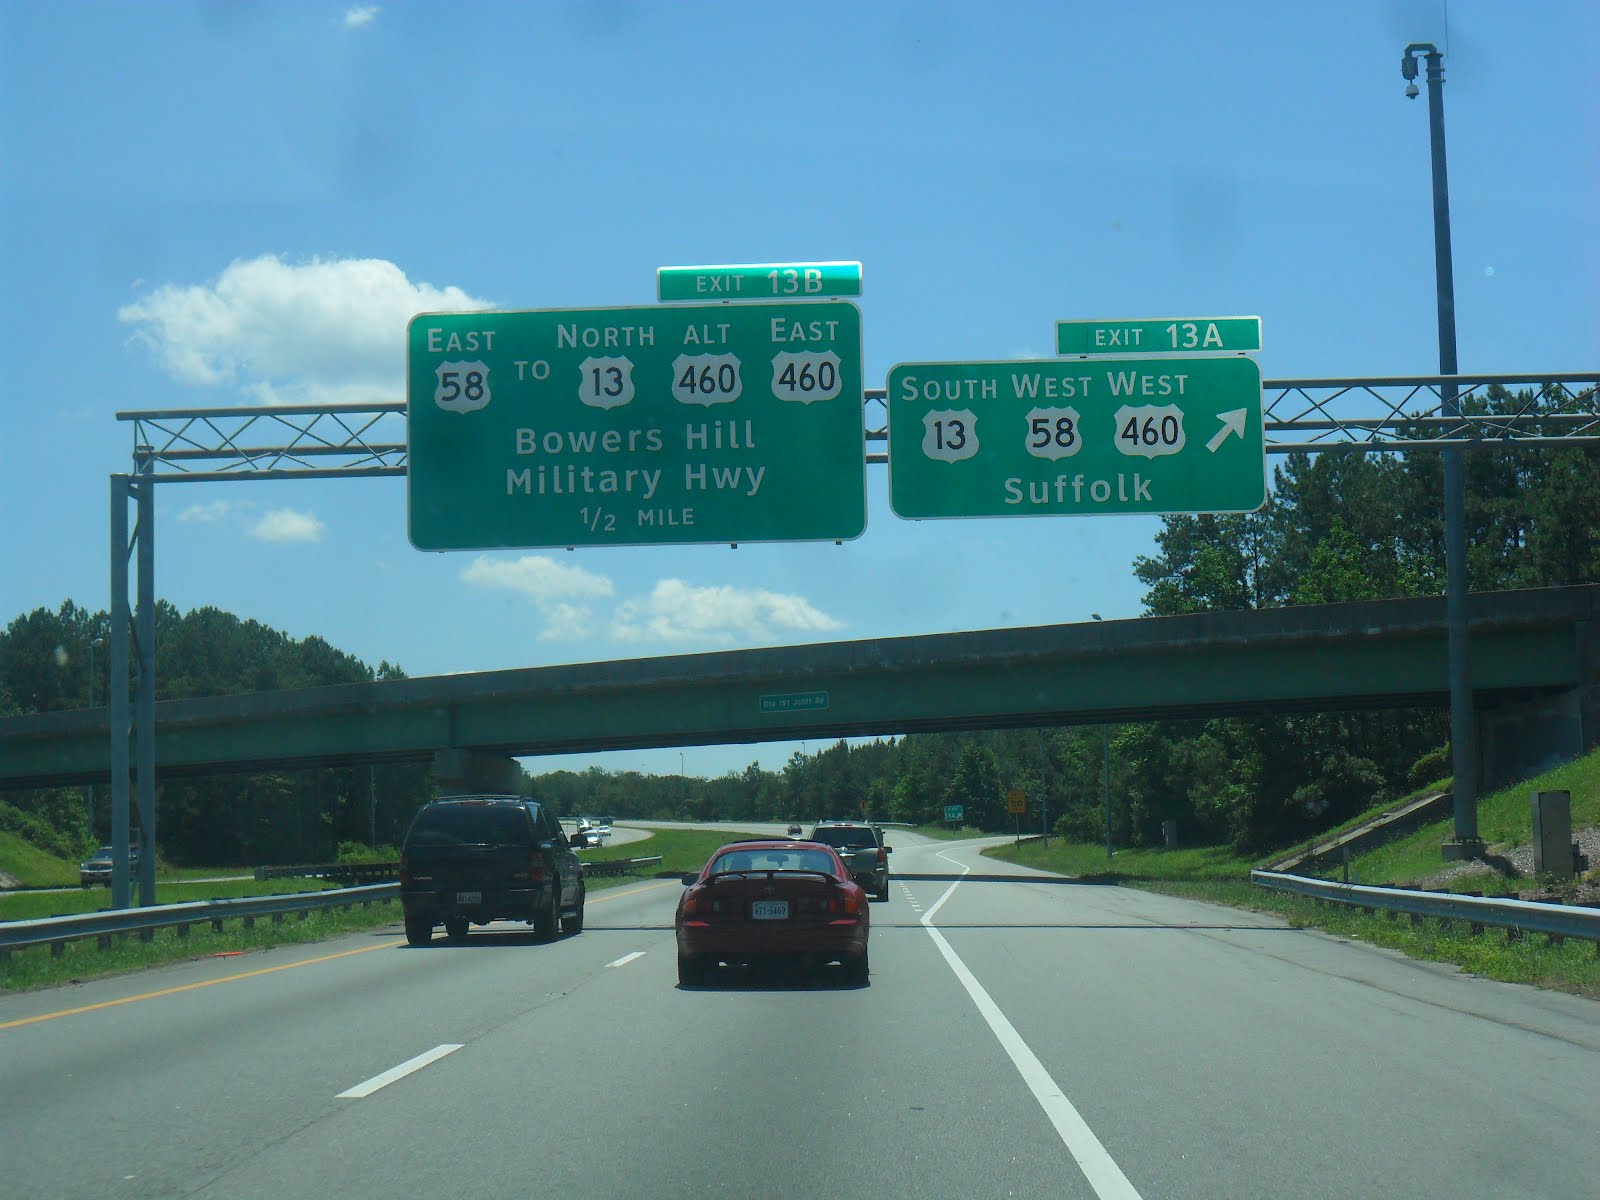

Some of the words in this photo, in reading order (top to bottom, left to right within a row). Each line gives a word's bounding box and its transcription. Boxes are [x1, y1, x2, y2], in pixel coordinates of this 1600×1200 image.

[697, 275, 744, 292] EXIT
[768, 268, 822, 293] 13B
[684, 324, 730, 344] ALT
[1096, 329, 1142, 346] EXIT
[1167, 323, 1223, 348] 13A
[442, 372, 483, 401] 58
[514, 360, 550, 380] TO
[593, 367, 623, 396] 13
[679, 364, 735, 394] 460
[779, 362, 835, 391] 460
[517, 428, 662, 454] Bowers
[687, 420, 755, 449] Hill
[935, 420, 965, 450] 13
[1033, 418, 1074, 448] 58
[1122, 416, 1178, 445] 460
[507, 465, 661, 499] Military
[686, 464, 765, 496] Hwy
[1005, 473, 1152, 504] Suffolk
[580, 507, 615, 531] 1/2
[638, 508, 693, 526] MILE
